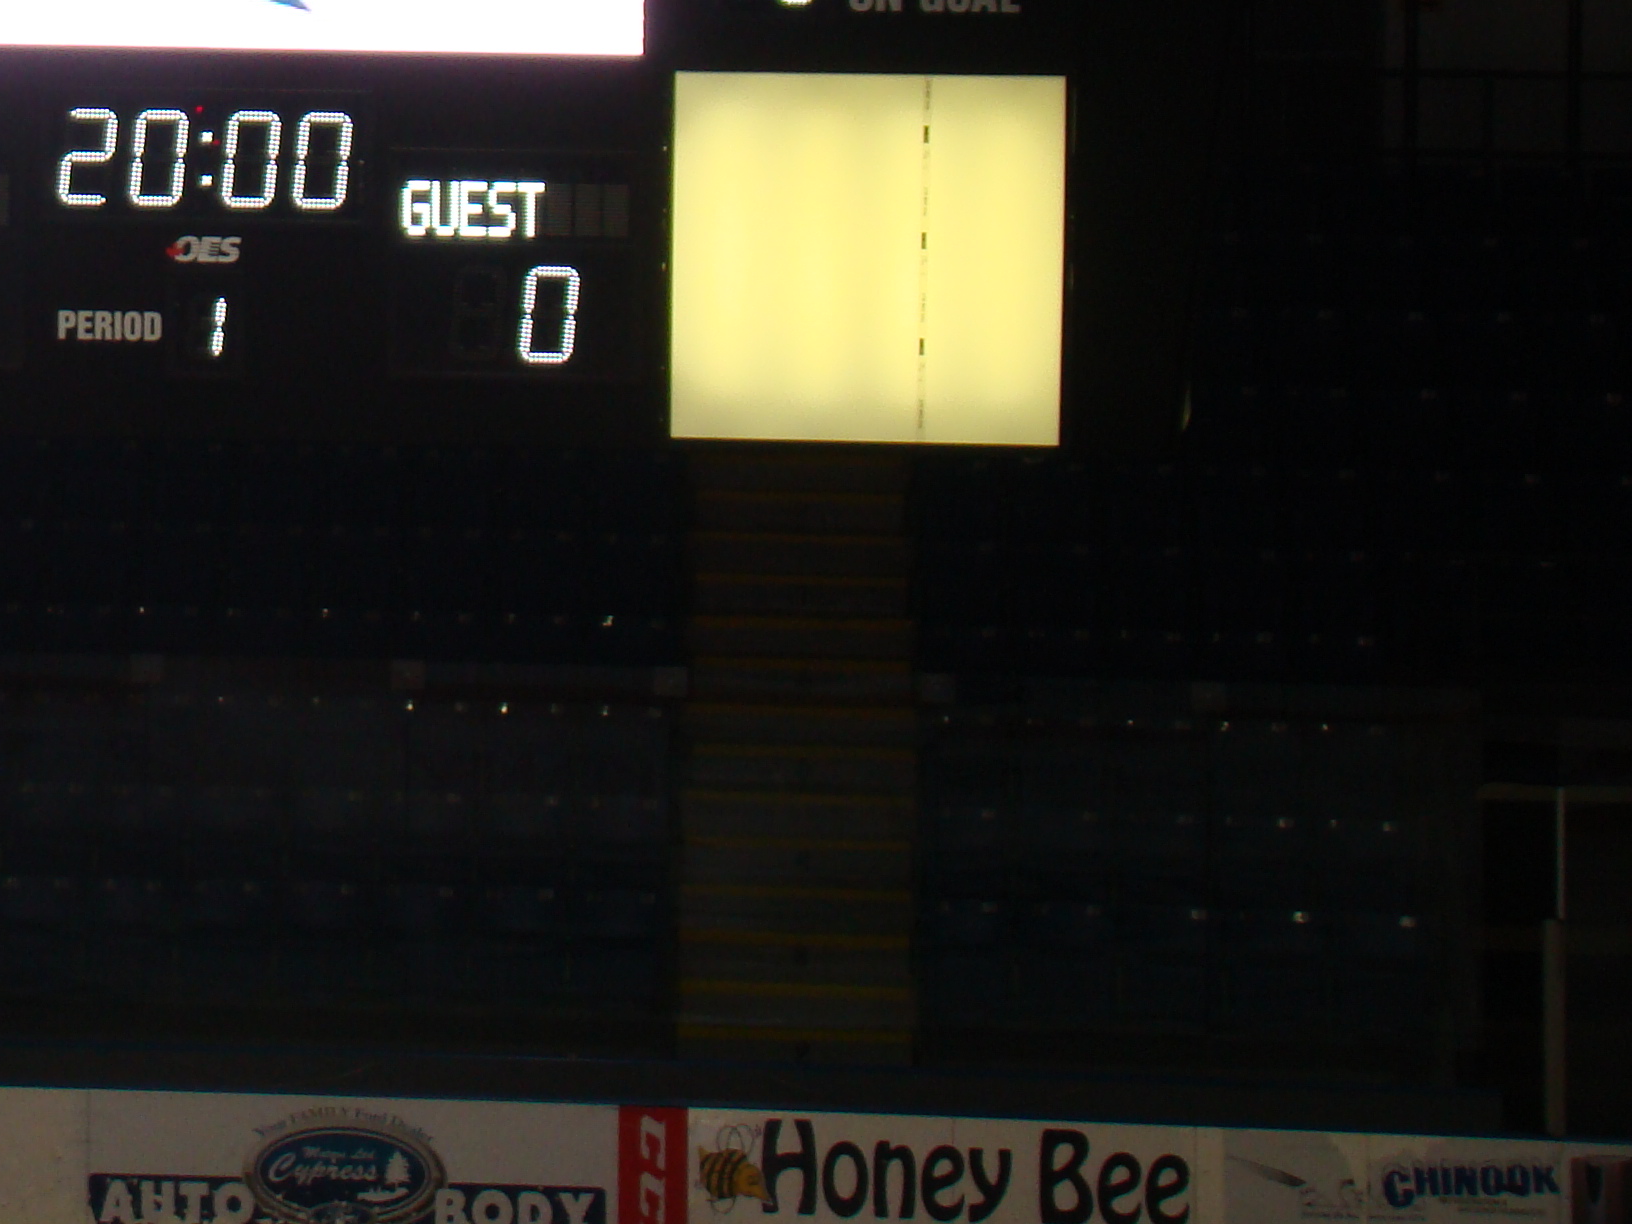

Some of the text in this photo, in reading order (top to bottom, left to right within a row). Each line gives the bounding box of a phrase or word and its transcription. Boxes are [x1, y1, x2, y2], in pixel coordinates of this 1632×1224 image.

[56, 106, 355, 211] 20:00
[399, 179, 547, 239] GUEST
[172, 235, 243, 264] OES
[57, 310, 163, 342] PERIOD
[208, 296, 229, 359] 1
[516, 264, 582, 365] 0
[269, 1152, 379, 1186] Cypress
[763, 1119, 1191, 1224] Honey Bee
[1383, 1165, 1560, 1208] CHINOOK
[99, 1178, 594, 1224] AUTO BODY
